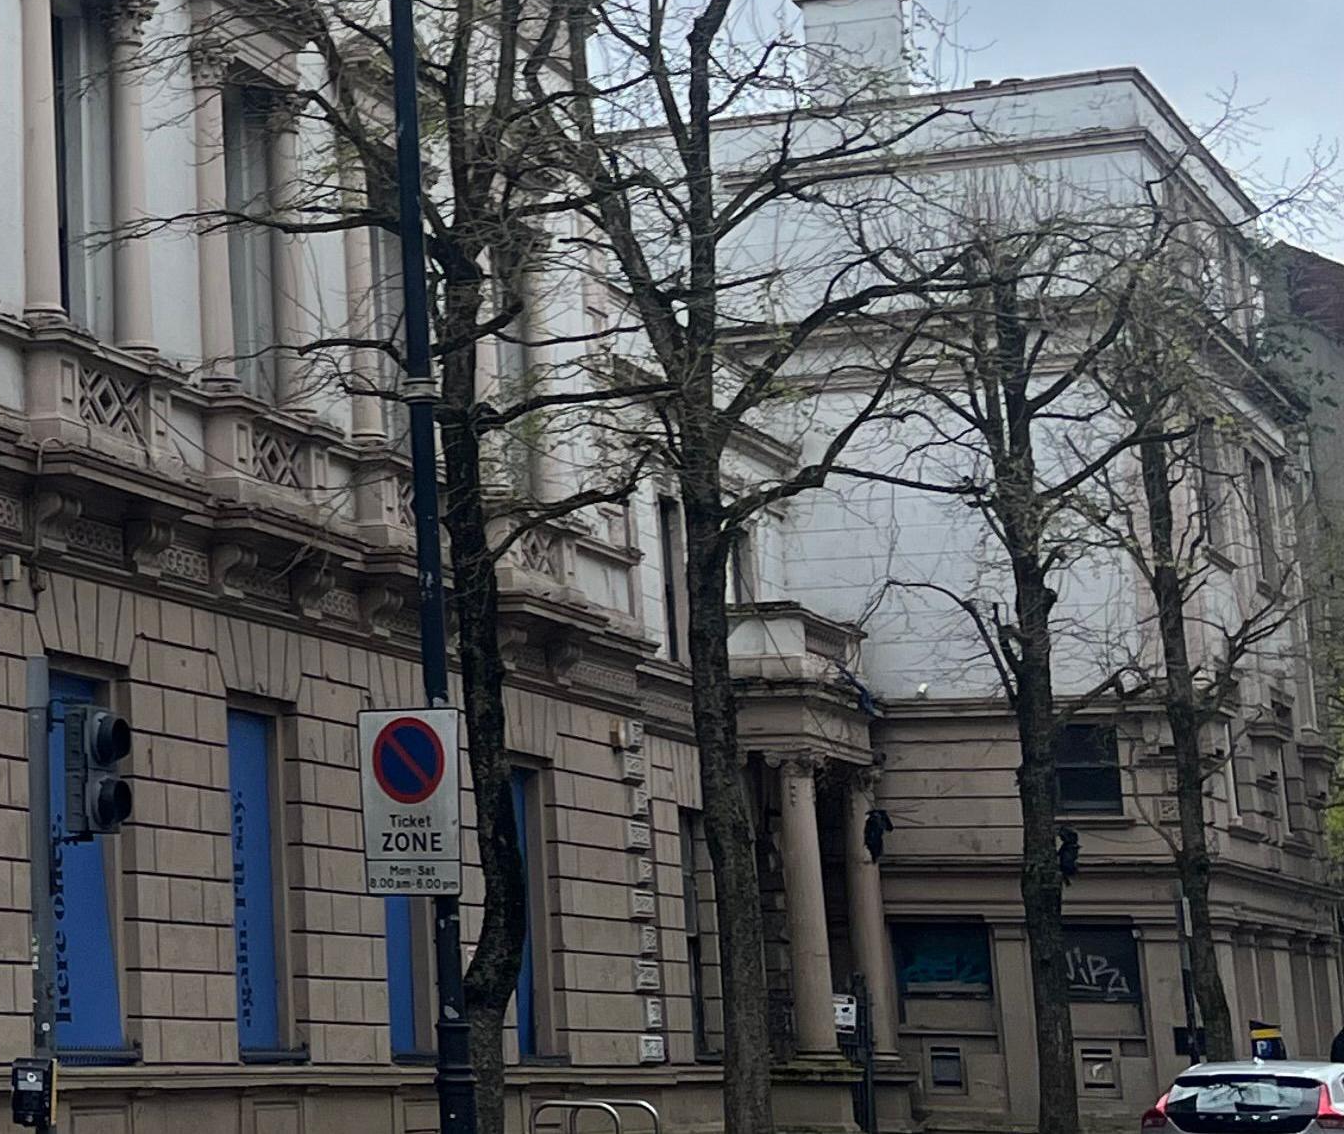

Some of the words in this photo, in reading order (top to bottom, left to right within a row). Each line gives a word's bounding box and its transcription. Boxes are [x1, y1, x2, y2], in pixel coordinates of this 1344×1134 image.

[389, 814, 432, 827] Ticket
[381, 832, 443, 852] ZONE
[55, 930, 72, 1023] here
